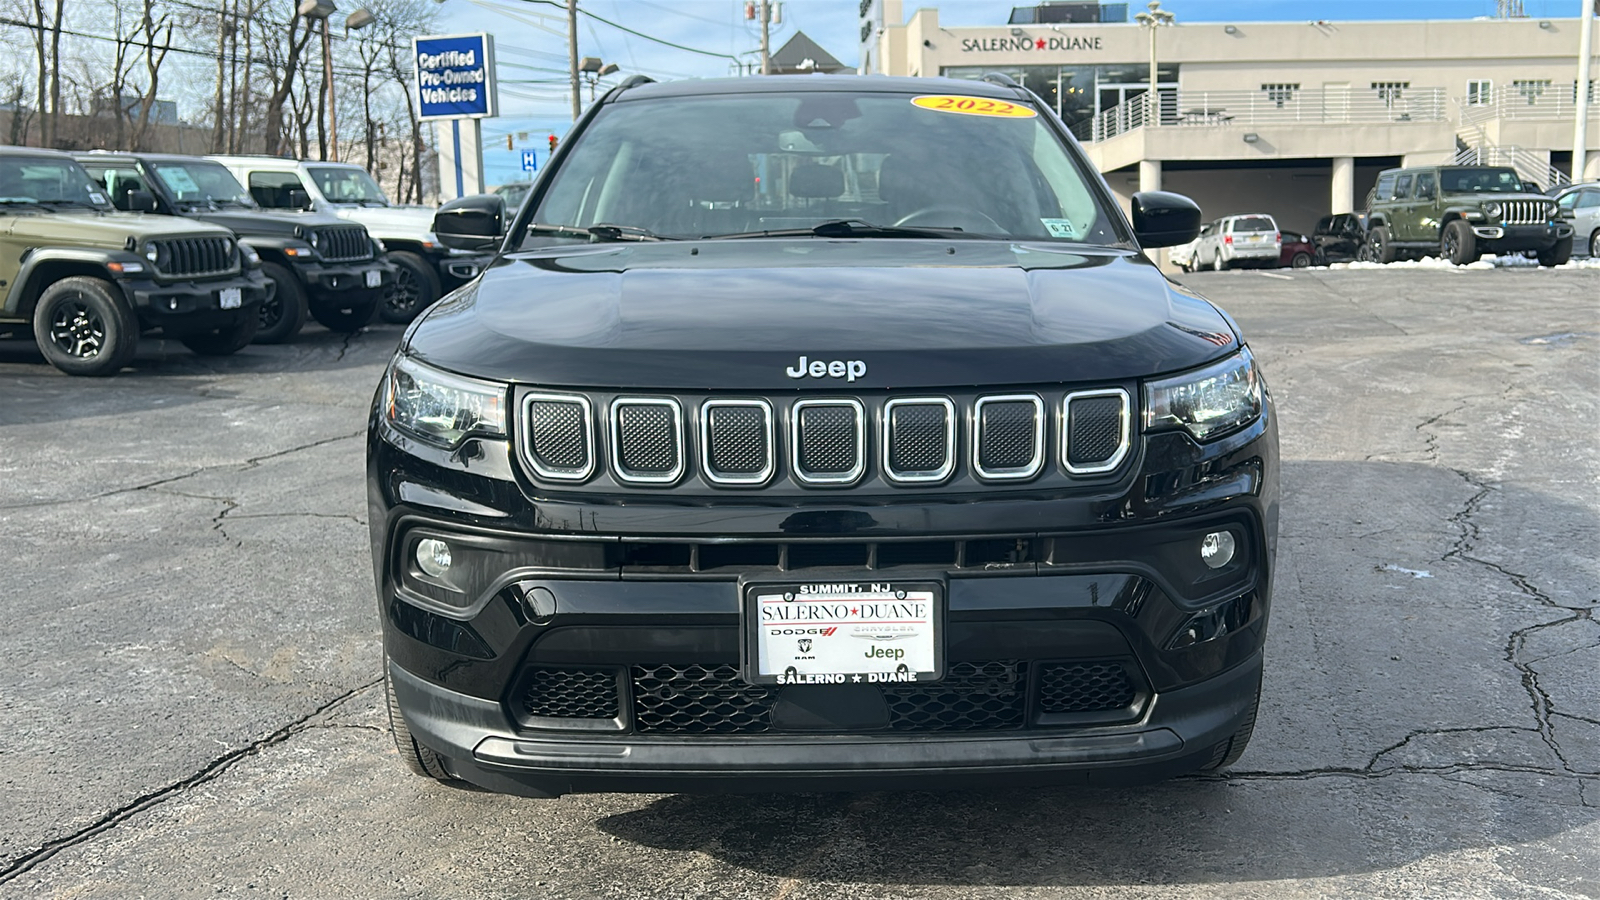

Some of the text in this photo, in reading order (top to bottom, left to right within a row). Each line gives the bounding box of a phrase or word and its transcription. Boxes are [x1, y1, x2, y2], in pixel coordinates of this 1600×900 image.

[962, 37, 1102, 52] SALERNO DUANE
[419, 50, 475, 69] Certified
[420, 67, 484, 86] Pre-Owned
[421, 87, 477, 104] Vehicles
[936, 98, 1015, 114] 2022
[523, 152, 534, 165] H
[786, 356, 867, 382] Jeep
[800, 583, 891, 594] SUMMIT, NJ
[762, 603, 927, 621] SALERNO DUANE
[771, 628, 828, 636] DODGE
[864, 645, 905, 661] Jeep
[776, 672, 918, 685] SALERNO DUANE
